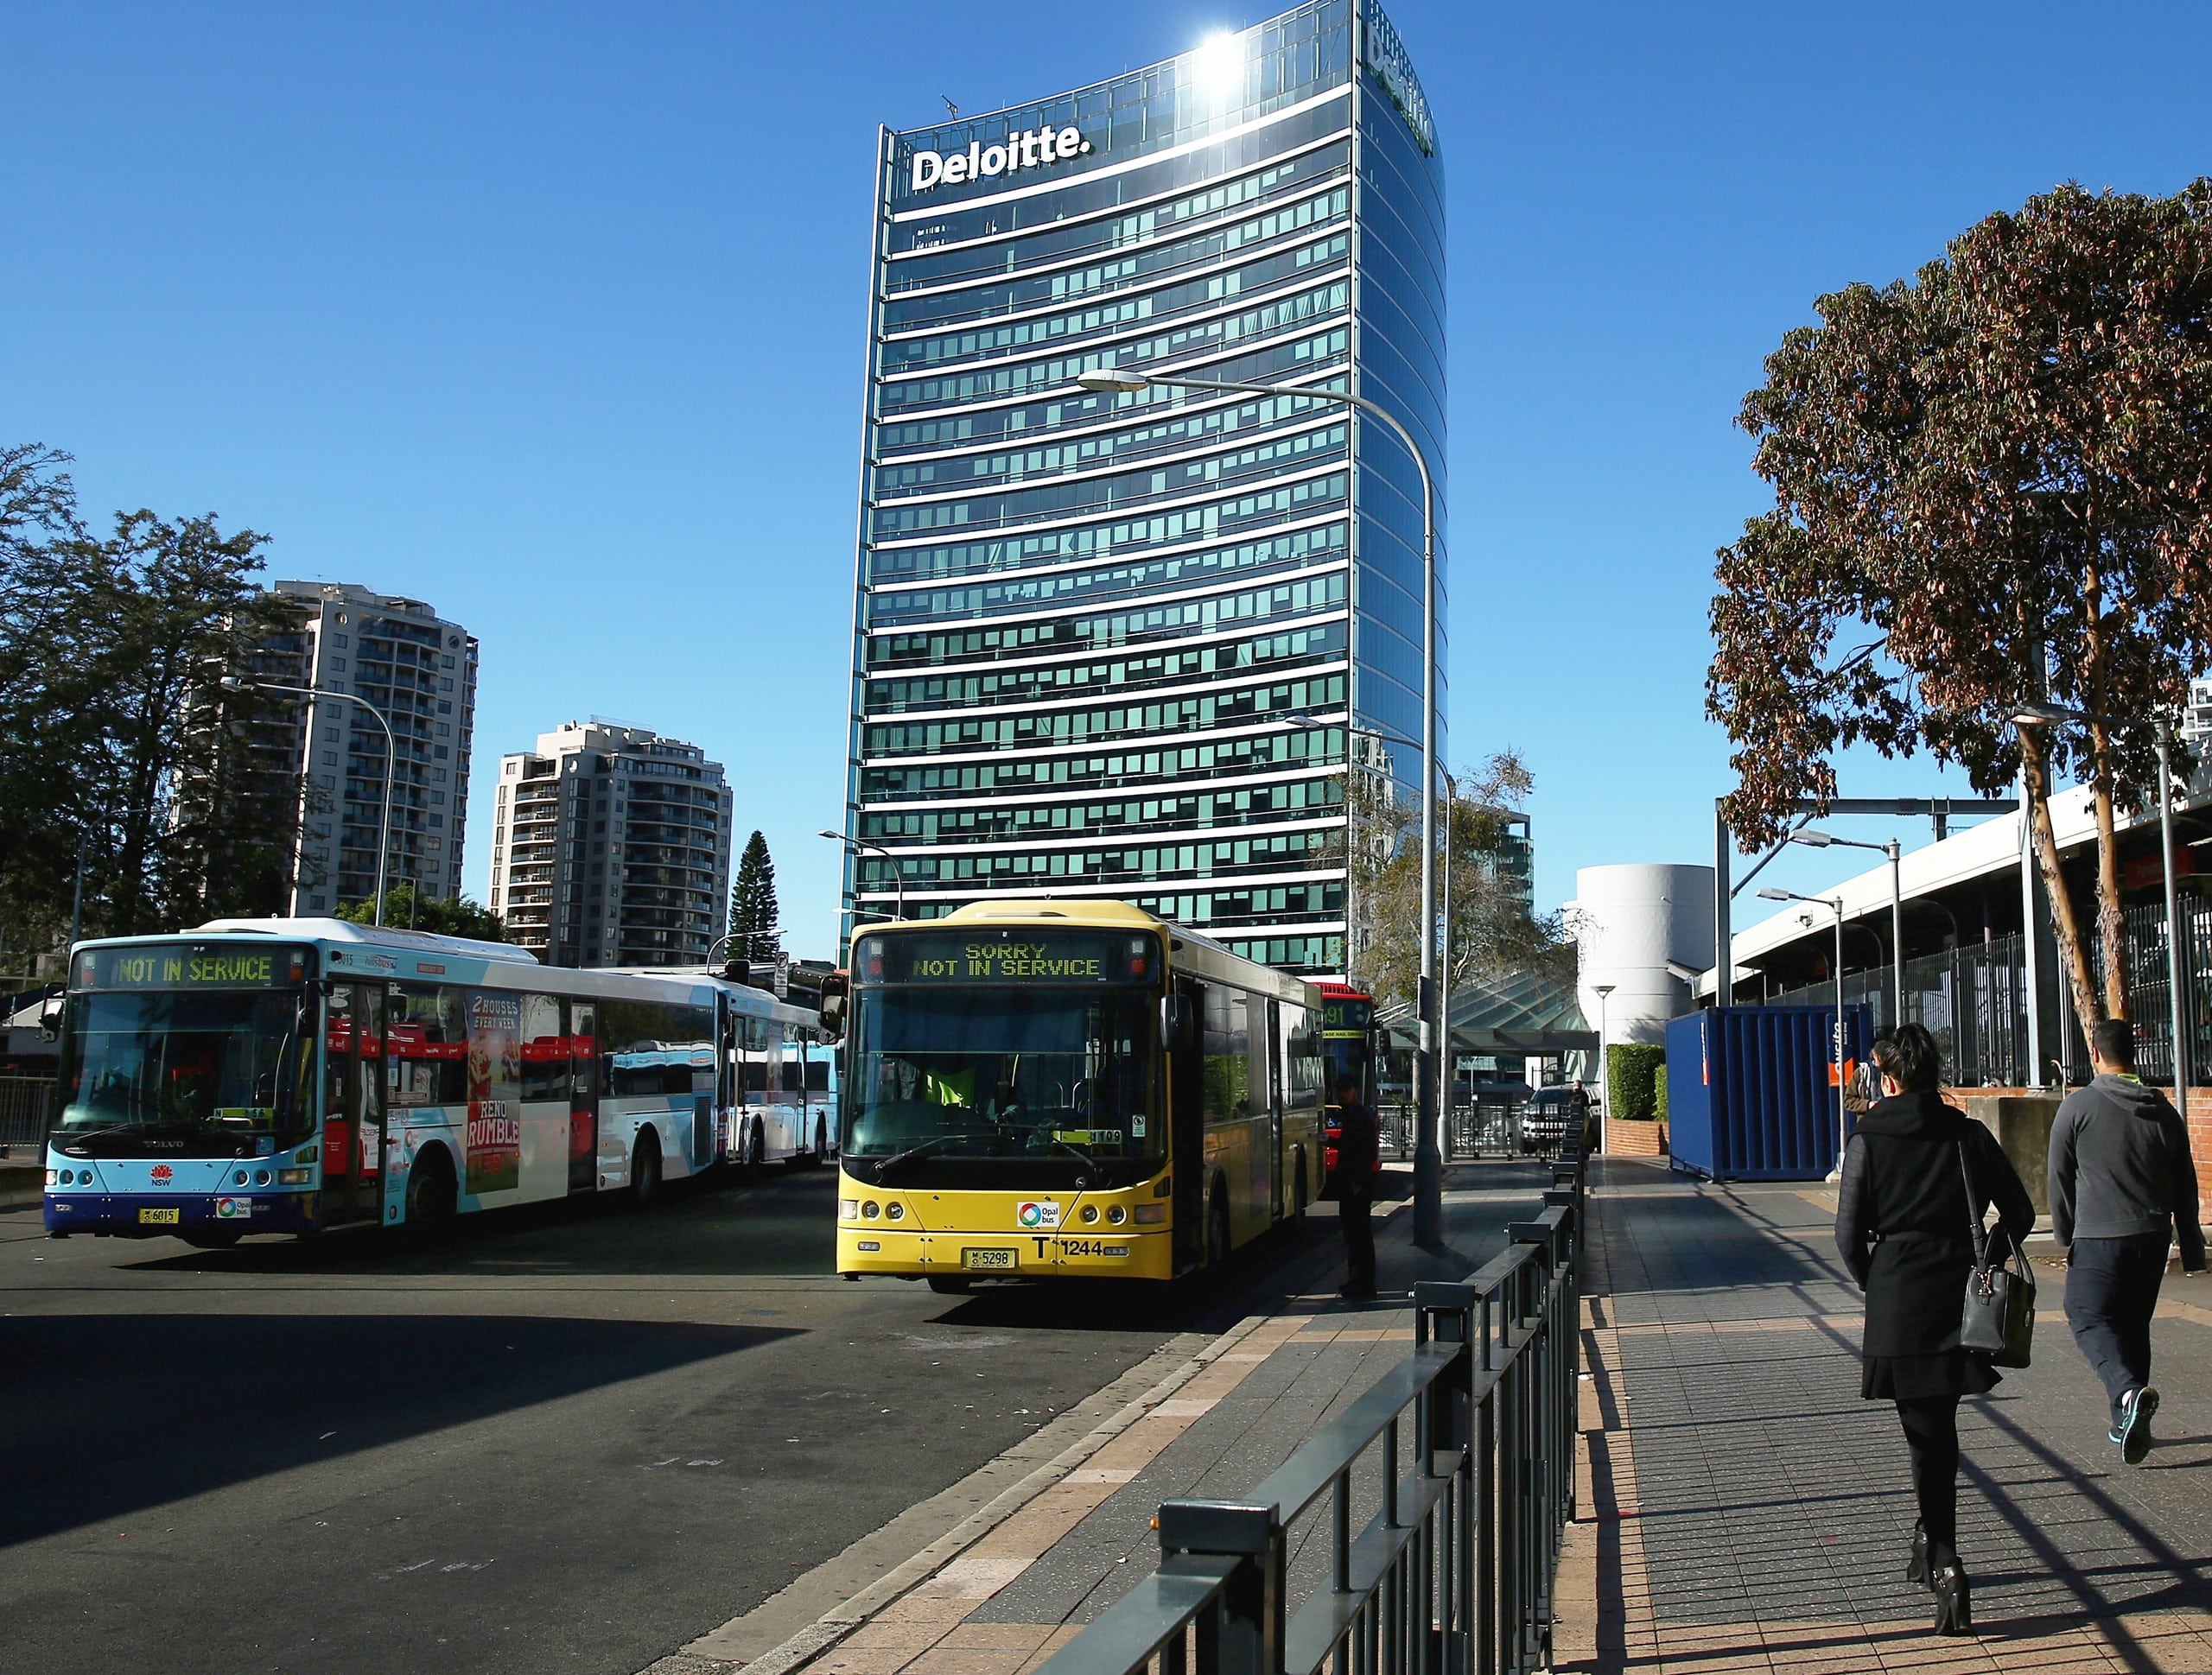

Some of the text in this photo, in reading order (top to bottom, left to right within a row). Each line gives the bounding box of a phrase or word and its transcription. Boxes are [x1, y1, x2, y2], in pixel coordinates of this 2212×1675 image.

[912, 124, 1090, 190] Deloitte.
[965, 943, 1047, 959] SORRY
[118, 955, 272, 982] NOT IN SERVICE
[913, 960, 1100, 975] NOT IN SERVICE
[473, 996, 518, 1014] 2 HOUSES
[474, 1017, 516, 1029] EVERY WEEK
[480, 1101, 507, 1118] RENO
[467, 1119, 518, 1147] RUMBLE
[237, 1202, 251, 1212] Opal
[1042, 1207, 1058, 1217] Opal
[153, 1210, 174, 1221] 6015
[1032, 1236, 1103, 1259] T 1244
[982, 1252, 1008, 1265] 5298
